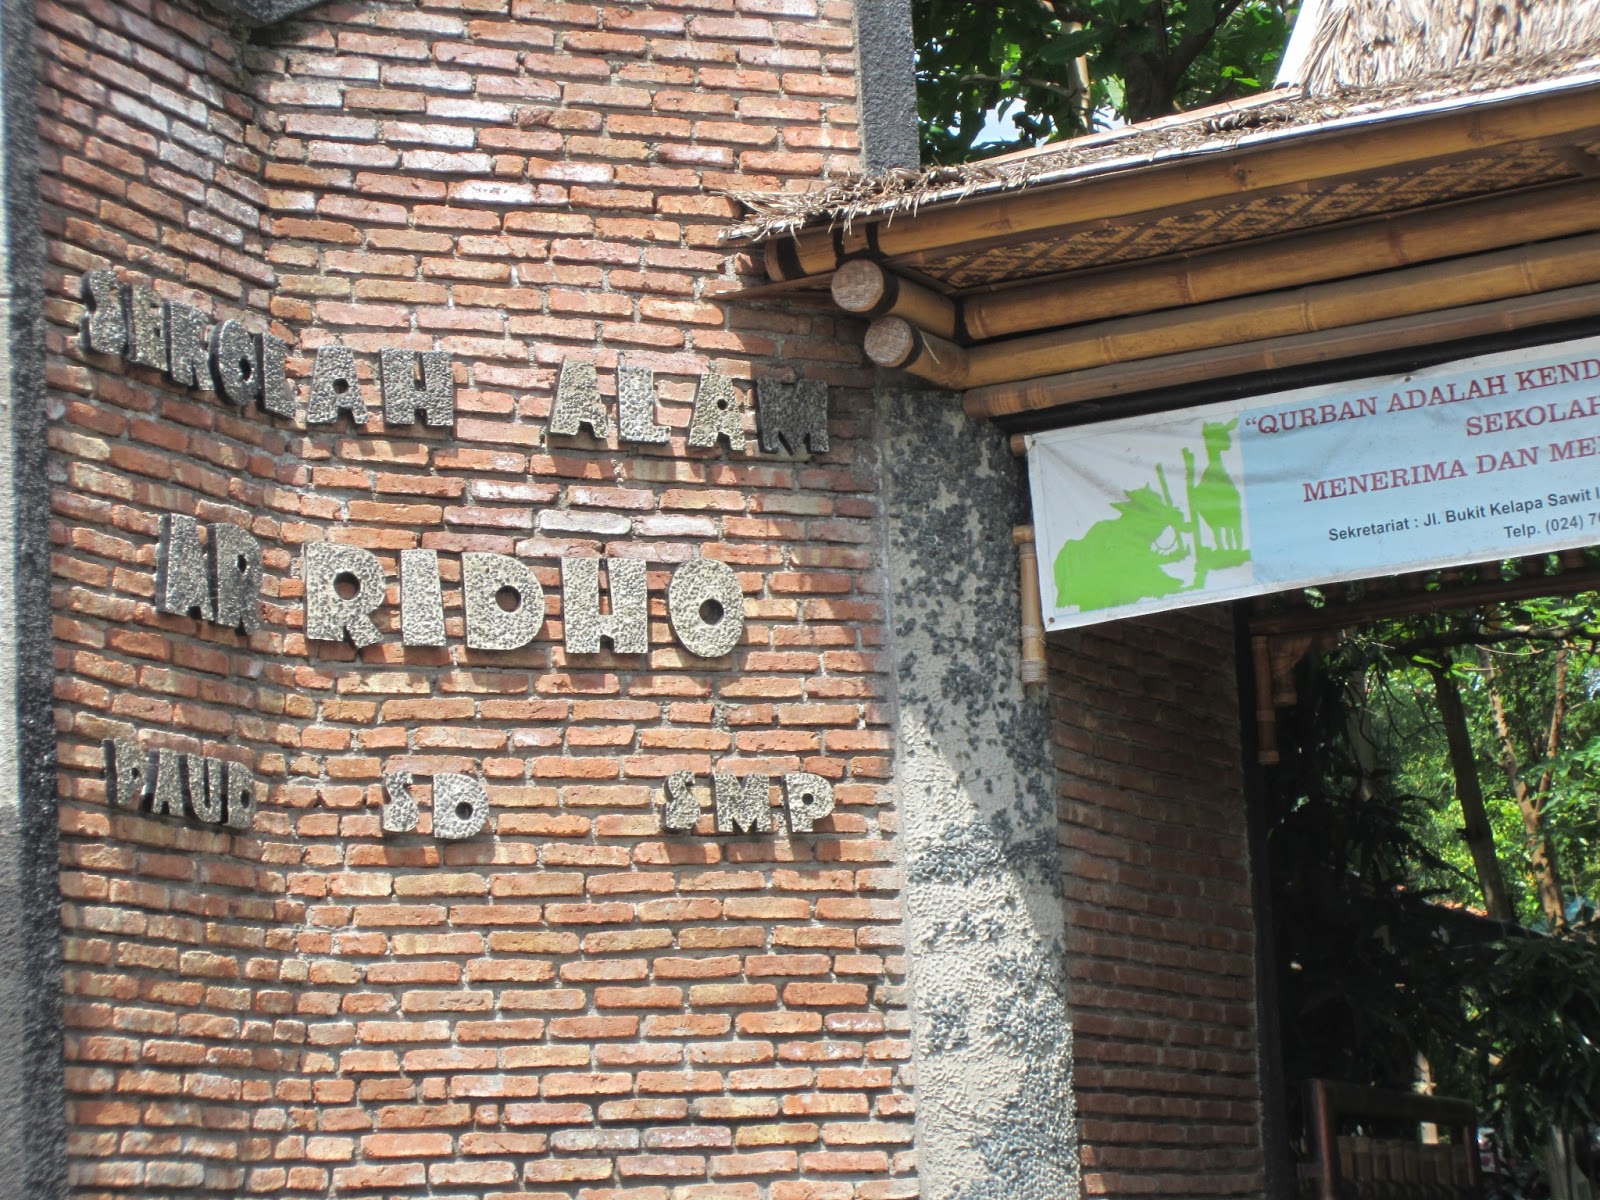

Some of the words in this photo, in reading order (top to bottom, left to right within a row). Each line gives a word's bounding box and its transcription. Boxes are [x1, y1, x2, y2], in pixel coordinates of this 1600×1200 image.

[548, 358, 831, 456] ALAM
[1387, 374, 1508, 413] ADALAH
[1303, 459, 1468, 502] MENERIMA
[1475, 446, 1540, 474] DAN
[1548, 435, 1600, 463] ME
[1328, 518, 1410, 542] Sekretariat
[1445, 505, 1486, 524] Bukit
[1489, 498, 1543, 516] Kelapa
[1547, 488, 1592, 507] Sawit
[1503, 524, 1541, 539] Telp.
[1545, 515, 1584, 535] (024)
[154, 512, 264, 636] AR
[304, 540, 746, 659] RIDHO
[102, 736, 257, 831] PAUD
[381, 769, 490, 841] SD
[663, 769, 836, 836] SMP
